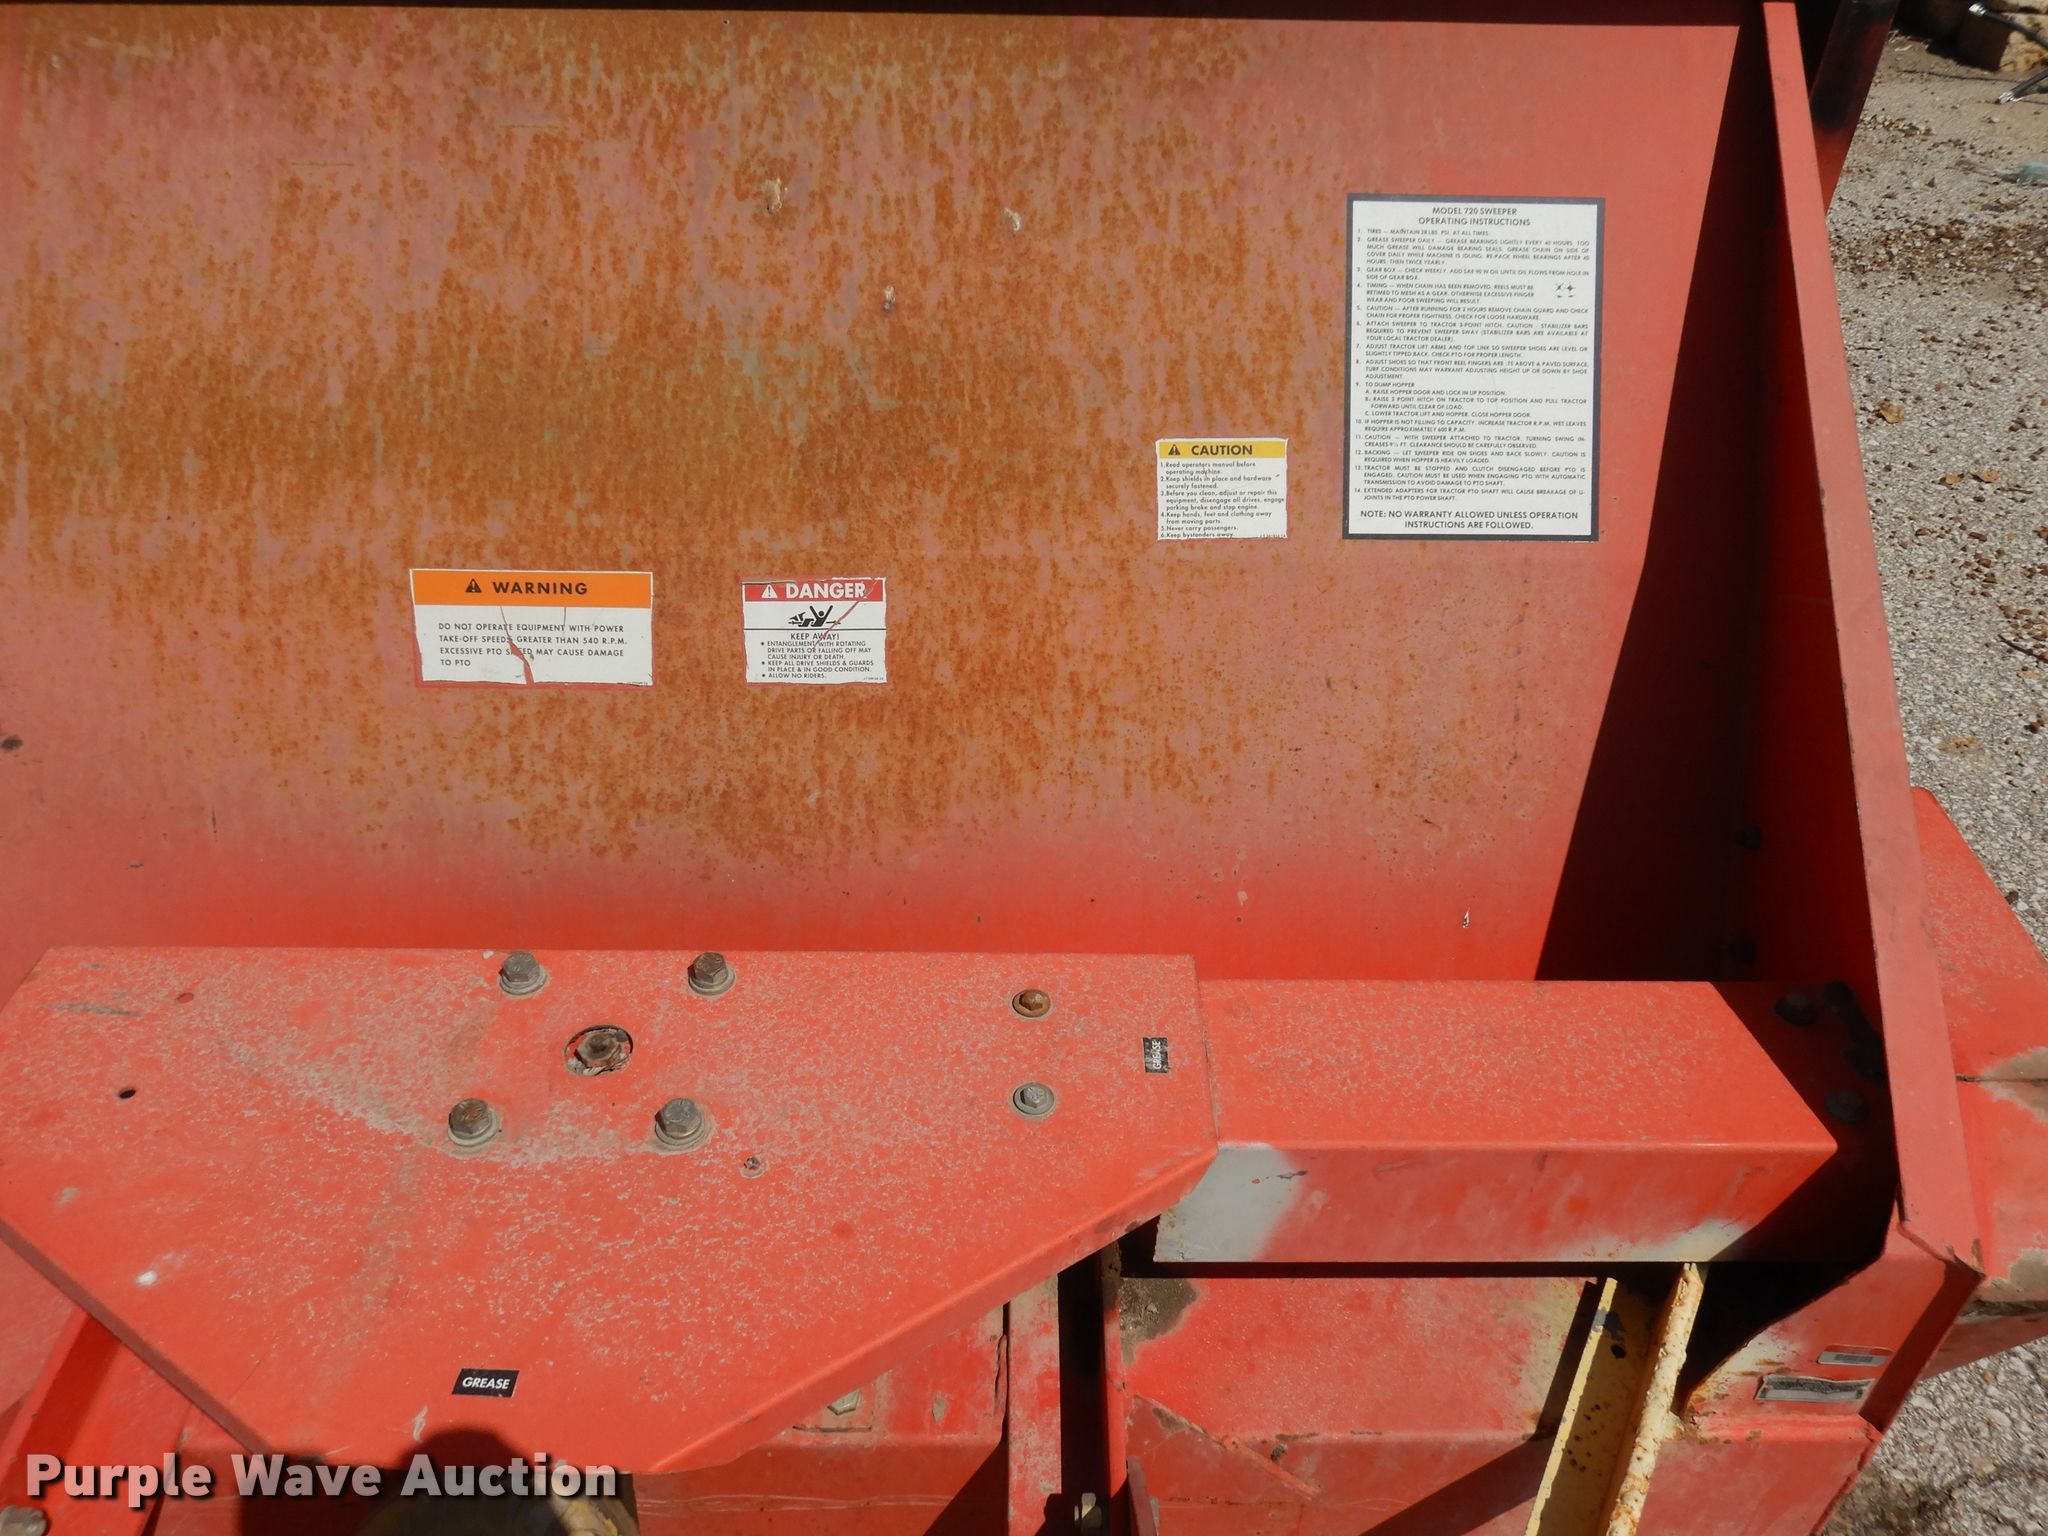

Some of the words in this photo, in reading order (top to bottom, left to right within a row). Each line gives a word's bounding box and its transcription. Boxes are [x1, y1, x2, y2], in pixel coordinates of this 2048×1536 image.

[1464, 207, 1478, 215] 720
[1418, 217, 1468, 225] OPERATING
[1470, 218, 1531, 226] INSTRUCTIONS
[1191, 445, 1253, 455] CAUTION
[1360, 510, 1386, 518] NOTE:
[1467, 521, 1483, 529] ARE
[492, 581, 588, 595] WARNING
[786, 582, 868, 599] DANGER
[439, 623, 451, 631] DO
[454, 623, 472, 631] NOT
[476, 623, 513, 631] OPERATE
[516, 624, 565, 632] EQUIPMENT
[569, 624, 590, 632] WITH
[594, 625, 624, 633] POWER
[516, 636, 552, 644] GREATER
[602, 637, 628, 645] R.P.M.
[440, 647, 483, 655] EXCESSIVE
[506, 648, 533, 656] SED
[536, 648, 553, 656] MAY
[588, 649, 624, 657] DAMAGE
[455, 659, 471, 667] PTO
[1151, 1039, 1162, 1070] GREASE
[462, 1376, 510, 1390] GREASE
